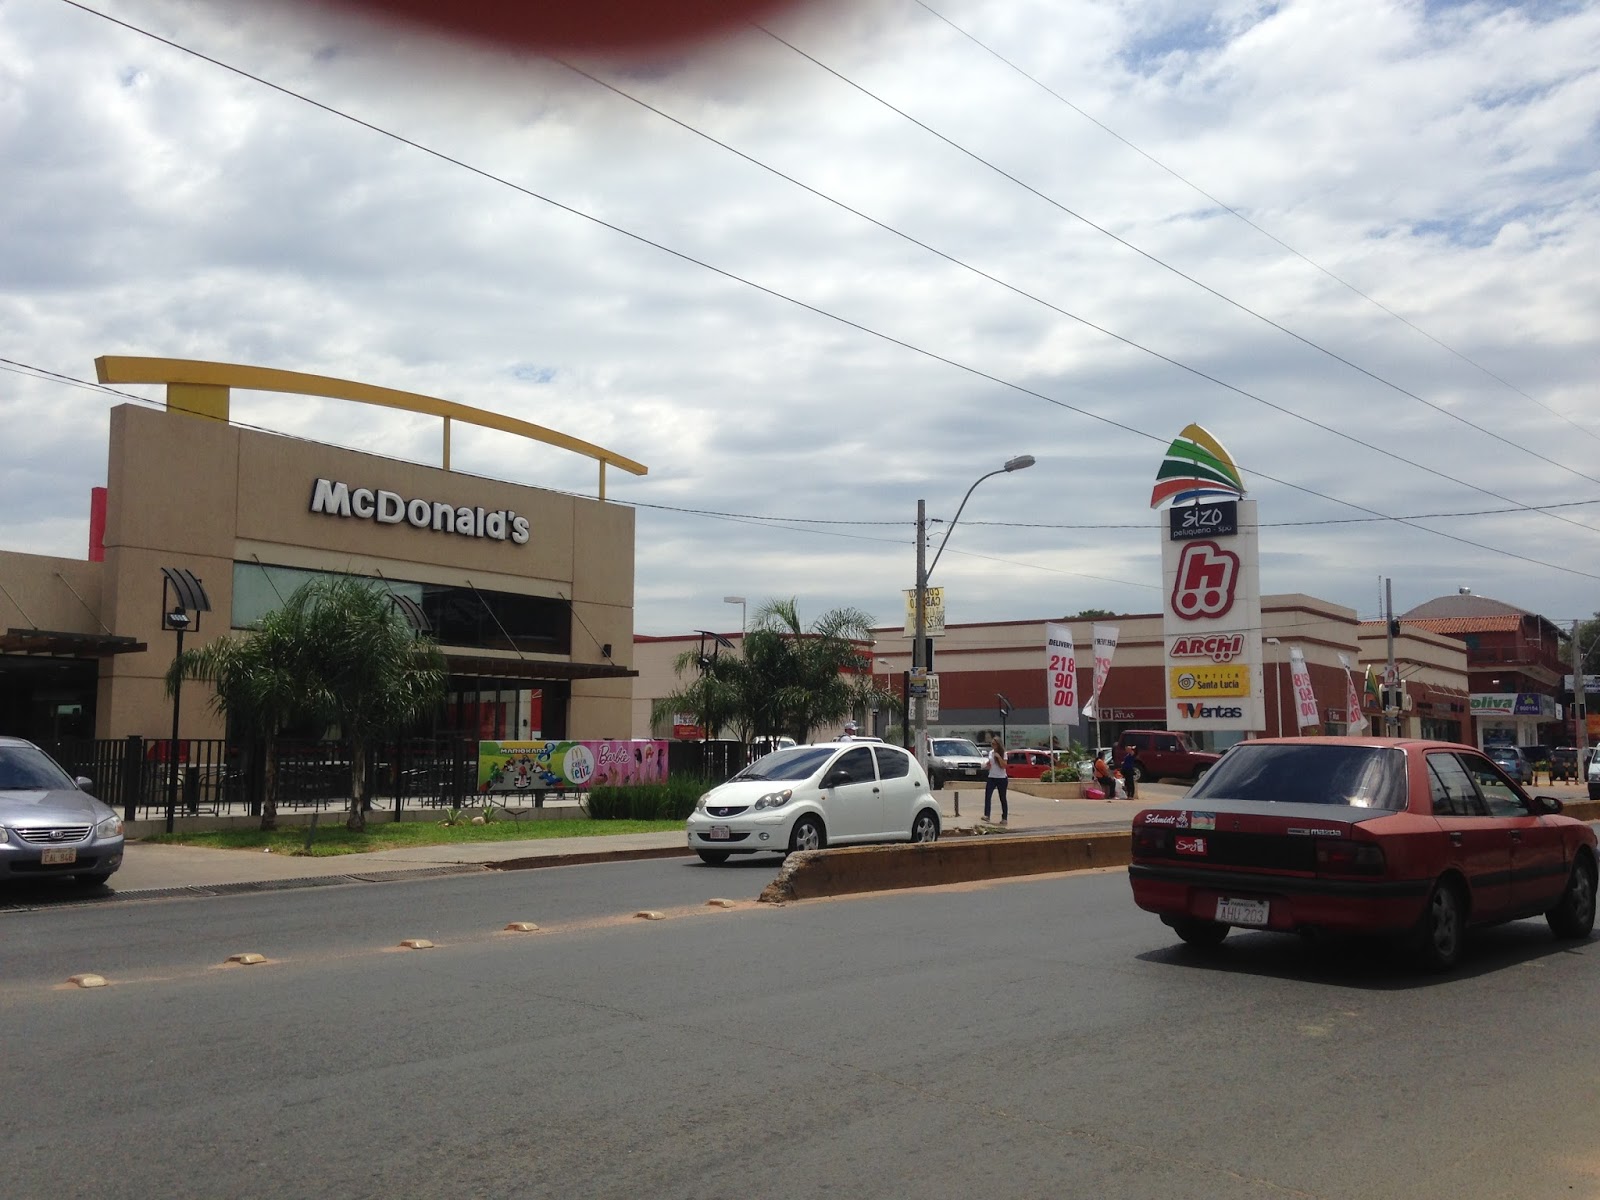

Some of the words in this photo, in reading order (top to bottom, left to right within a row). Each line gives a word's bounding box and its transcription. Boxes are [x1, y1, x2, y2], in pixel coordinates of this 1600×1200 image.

[310, 478, 530, 544] McDonald's
[1048, 638, 1072, 649] DELIVERY
[1049, 655, 1075, 673] 218
[1054, 673, 1073, 689] 90
[1197, 681, 1218, 689] Santa
[1054, 690, 1074, 707] 00
[598, 744, 630, 766] Barbie
[1145, 813, 1175, 824] Schmidt
[1221, 907, 1240, 920] AHU
